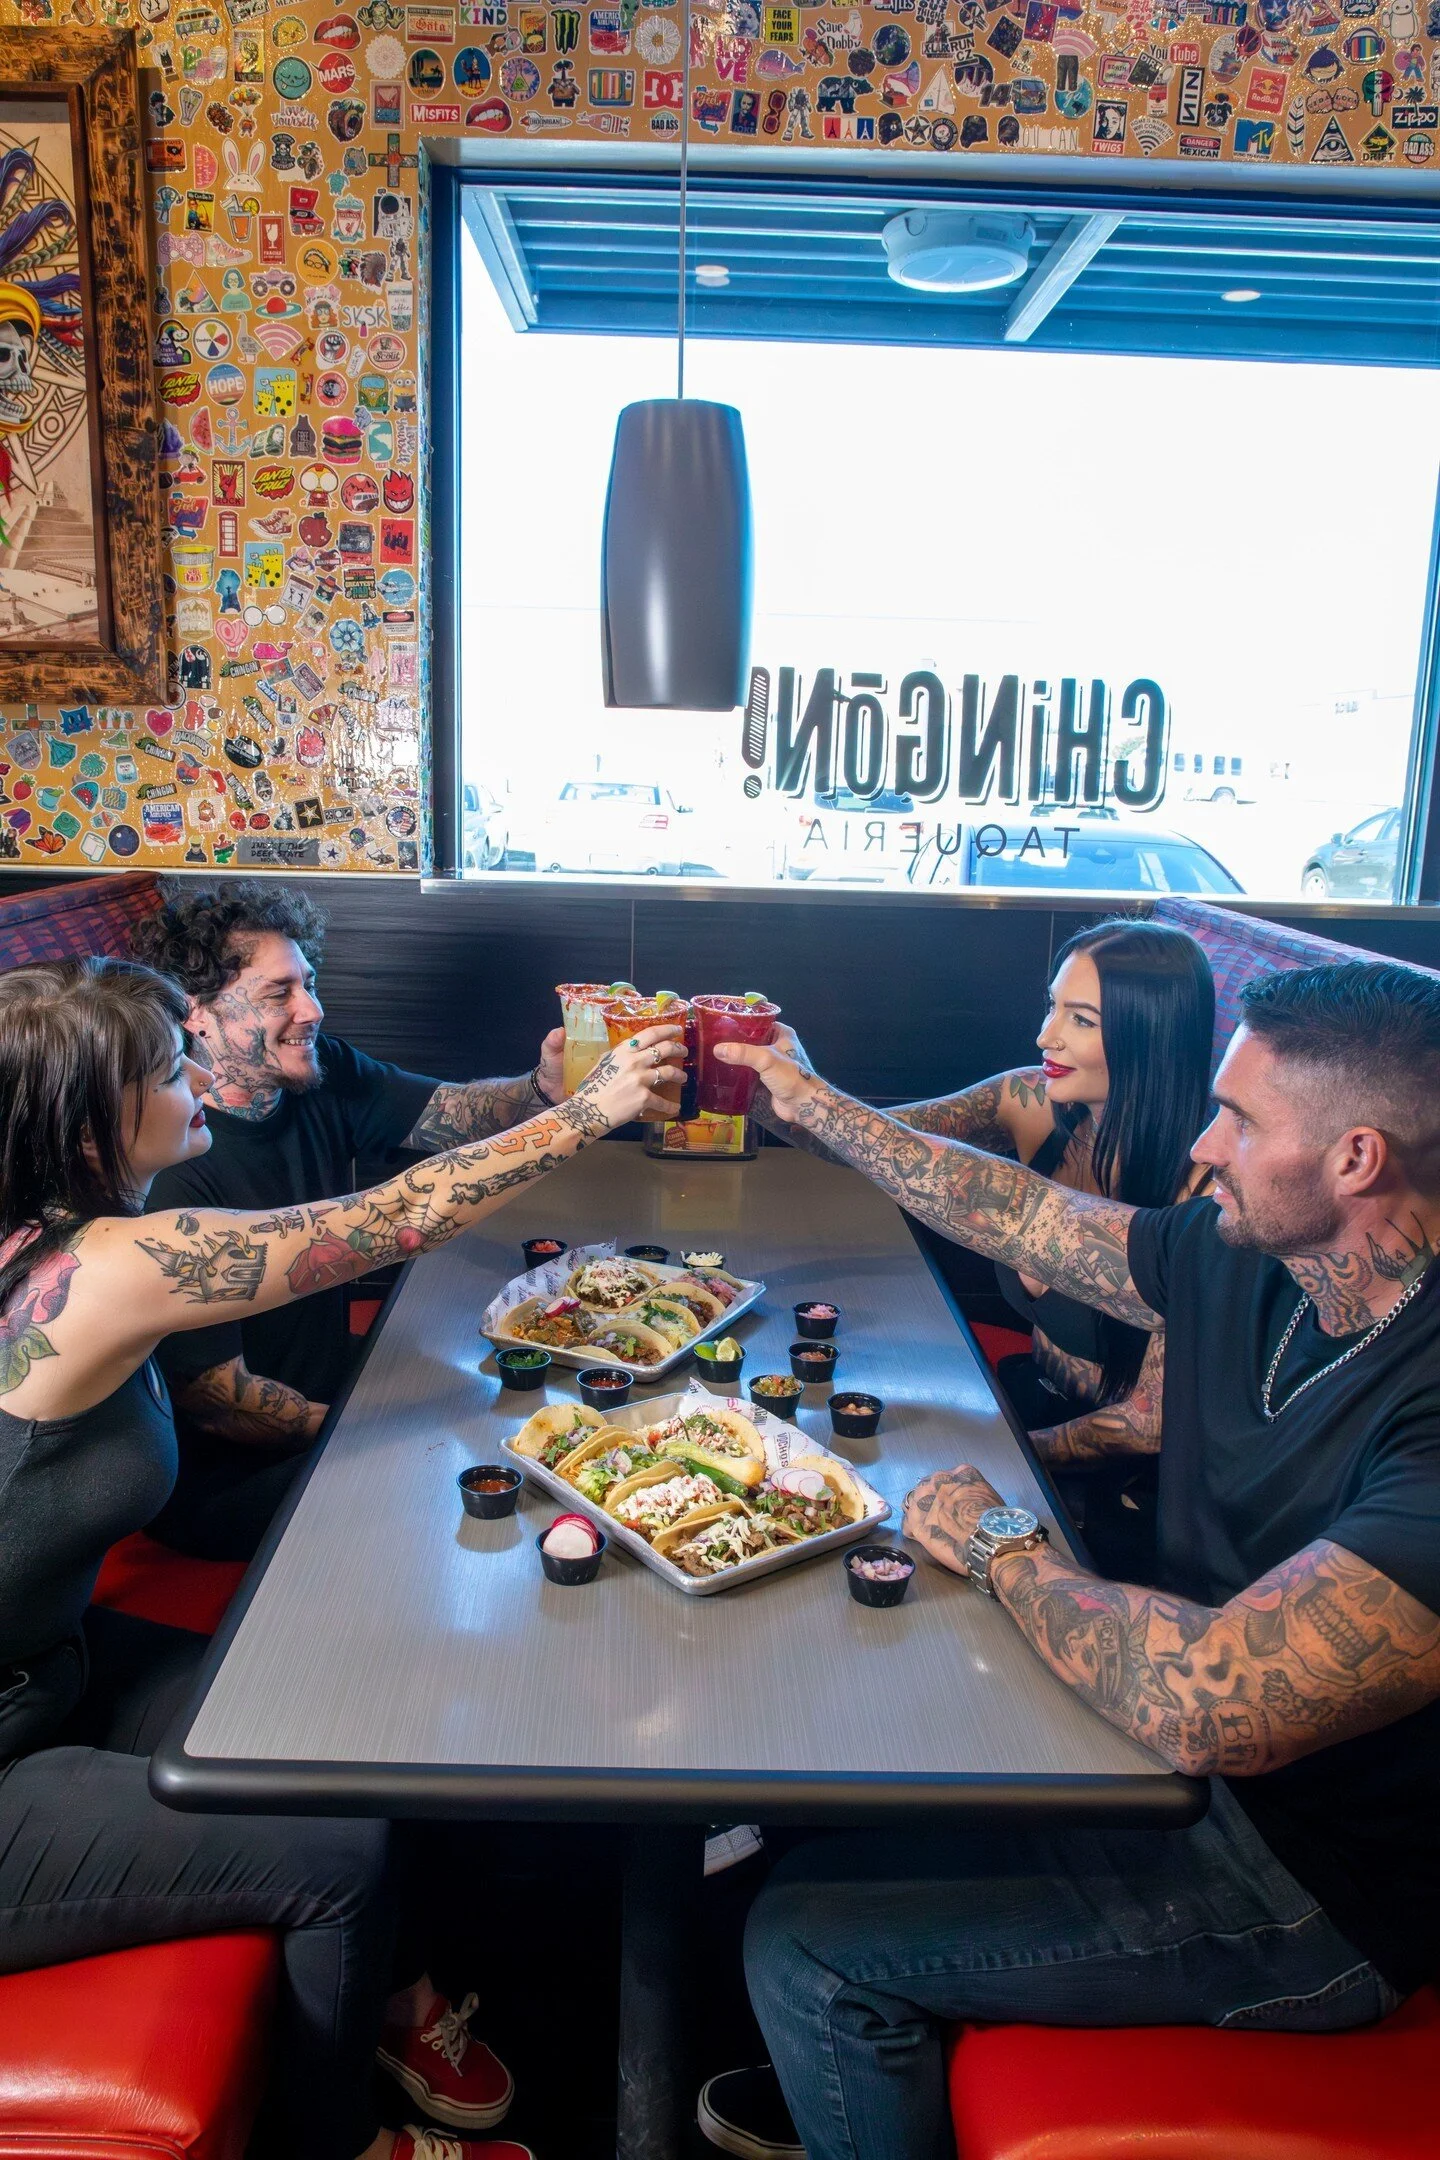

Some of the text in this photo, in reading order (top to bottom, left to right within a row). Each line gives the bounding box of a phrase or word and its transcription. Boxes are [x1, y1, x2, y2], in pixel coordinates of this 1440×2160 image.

[460, 8, 507, 25] KIND
[593, 11, 620, 20] AMERIC
[773, 10, 791, 19] FACE
[772, 21, 792, 30] YOUR
[817, 19, 843, 36] Save
[770, 32, 794, 42] FEARS
[951, 38, 975, 53] RUN
[956, 49, 972, 61] CZ
[319, 64, 356, 83] MARS
[1018, 126, 1039, 148] OU
[1094, 141, 1122, 153] TWIGS
[1180, 148, 1219, 158] MEXICAN
[1362, 152, 1395, 161] DRIFT
[208, 375, 245, 394] HOPE
[145, 804, 180, 812] AMERICAN
